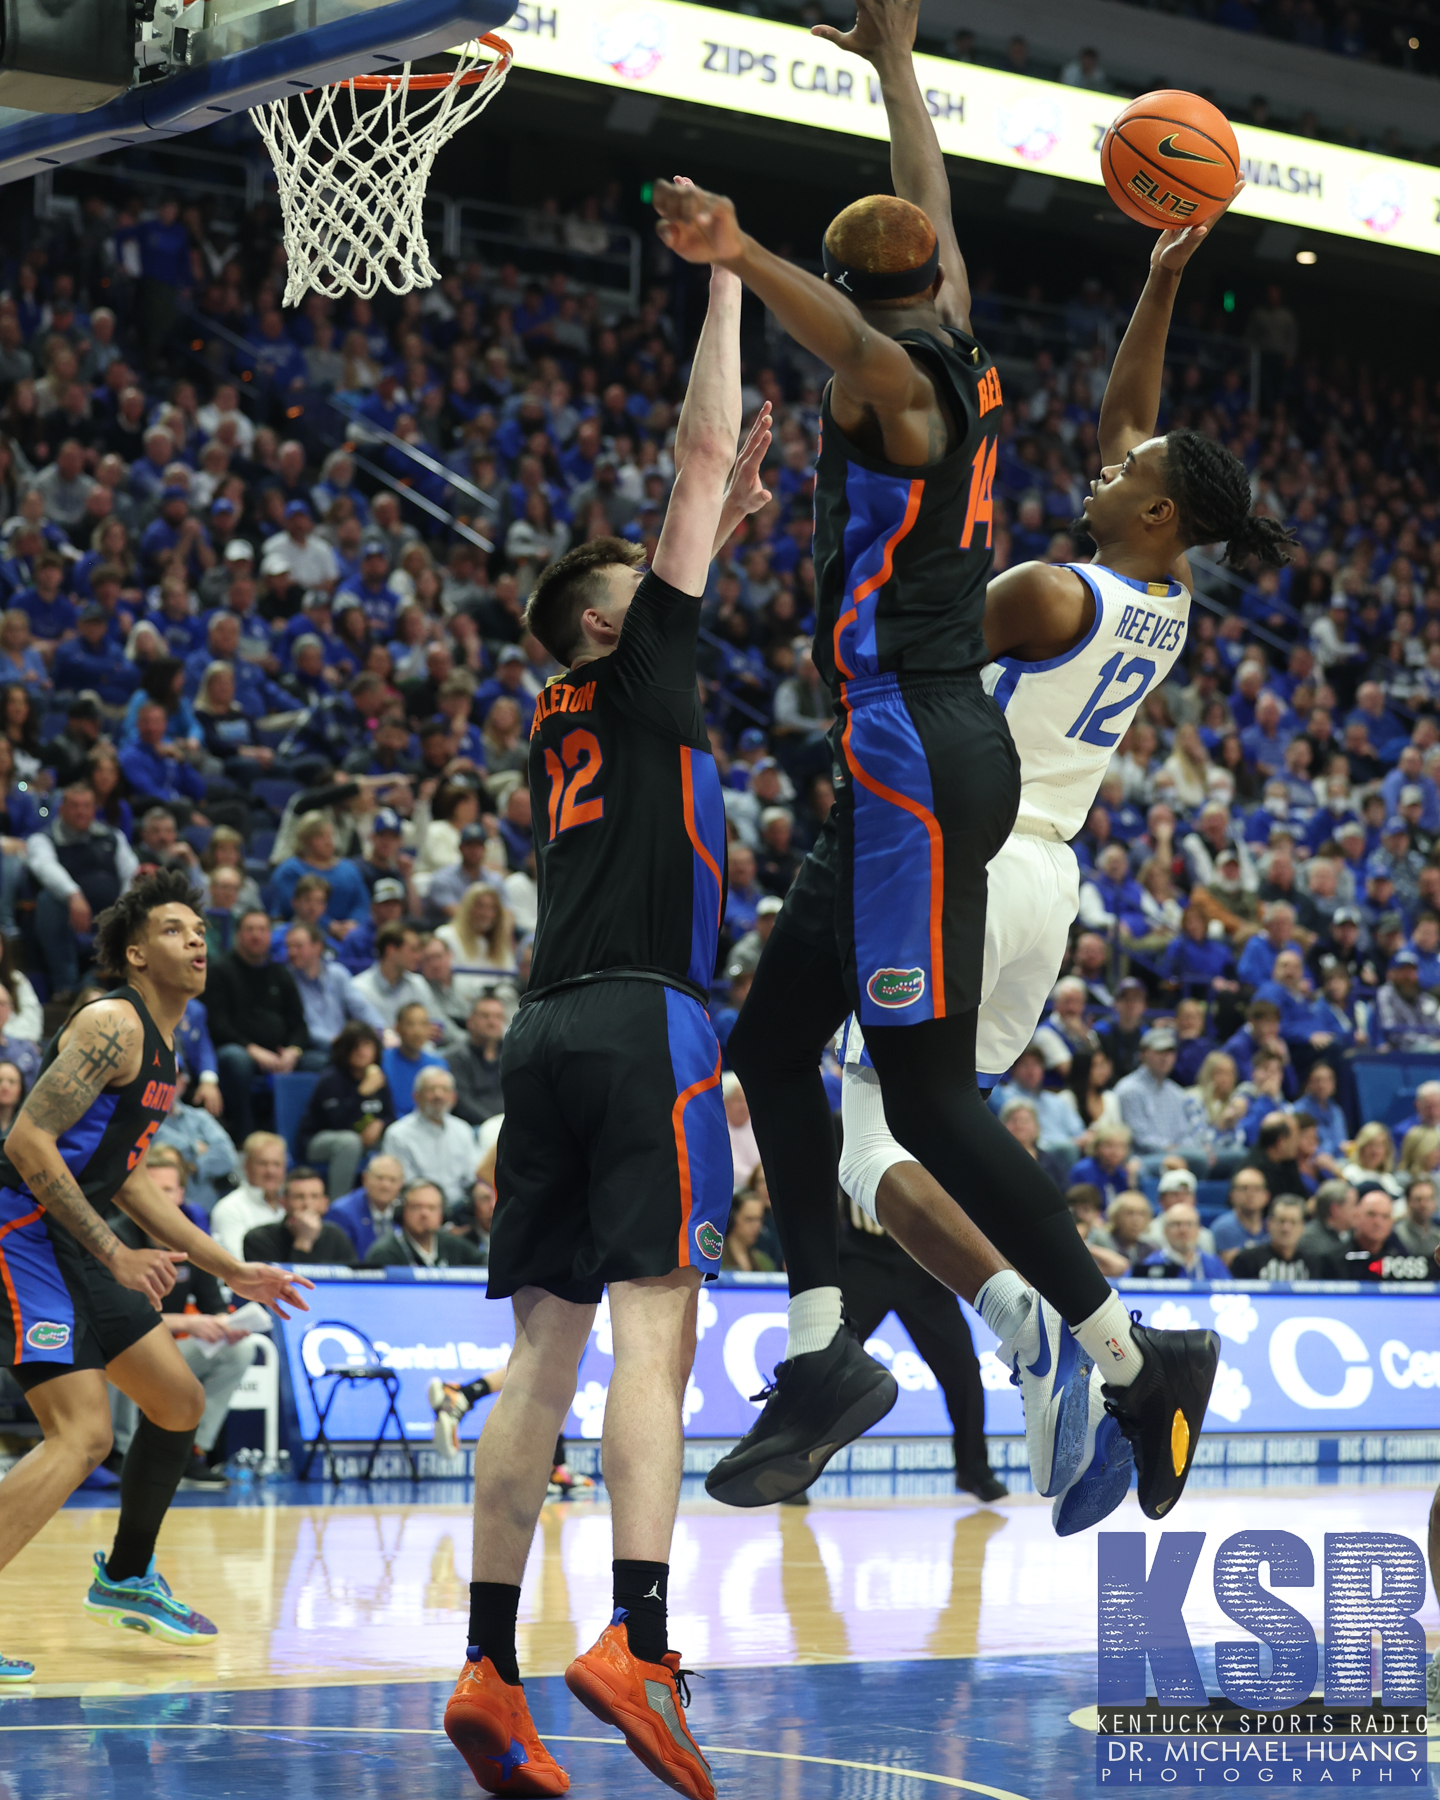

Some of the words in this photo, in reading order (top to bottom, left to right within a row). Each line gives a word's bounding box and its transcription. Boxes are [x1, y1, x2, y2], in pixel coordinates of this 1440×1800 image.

[502, 3, 557, 38] SH
[702, 40, 777, 84] ZIPS
[791, 60, 854, 99] CAR
[866, 75, 965, 124] WSH
[1130, 168, 1201, 217] ELITE
[977, 366, 1003, 419] REE
[959, 433, 998, 550] 14
[1114, 604, 1186, 652] REEVES
[1065, 651, 1157, 748] 12
[543, 727, 605, 843] 12
[141, 1079, 176, 1113] GATO
[126, 1120, 160, 1173] 5
